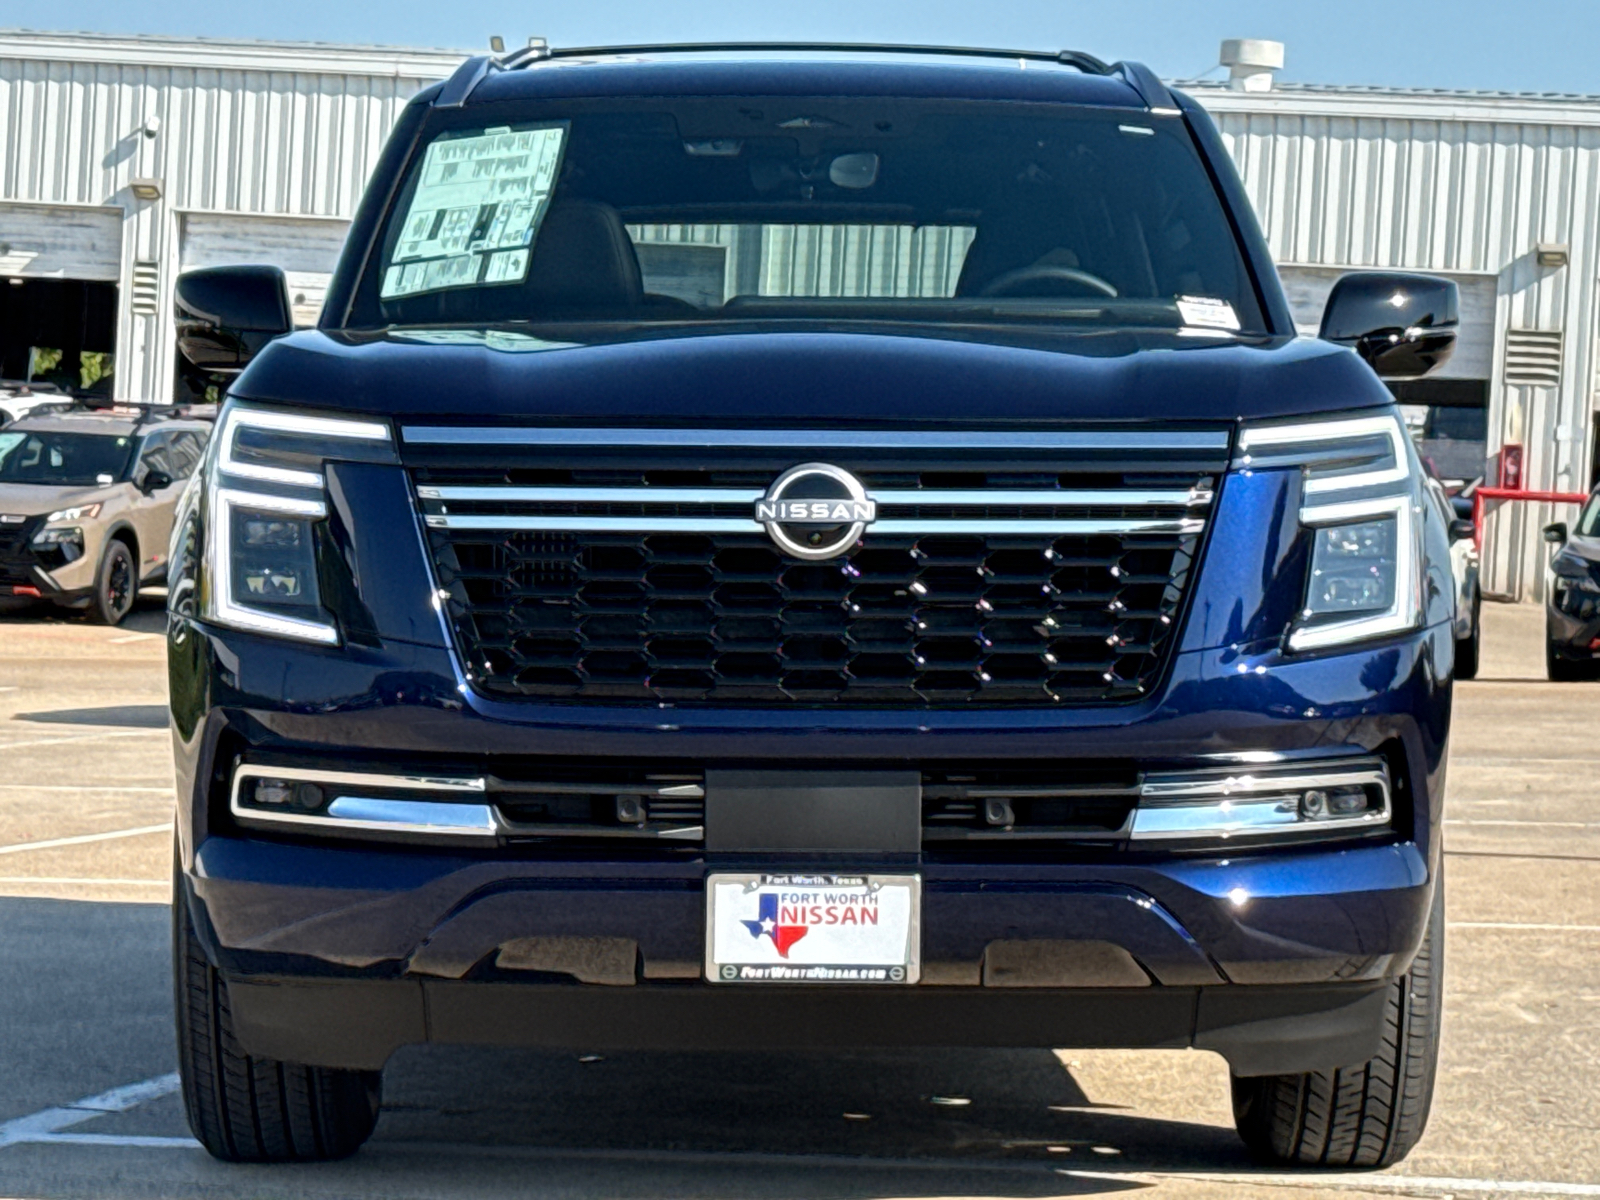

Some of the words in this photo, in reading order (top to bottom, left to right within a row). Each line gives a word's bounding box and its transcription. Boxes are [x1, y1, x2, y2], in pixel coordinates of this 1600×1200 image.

[758, 502, 872, 519] NISSAN
[781, 893, 819, 904] FORT
[824, 893, 878, 905] WORTH
[781, 906, 878, 925] NISSAN
